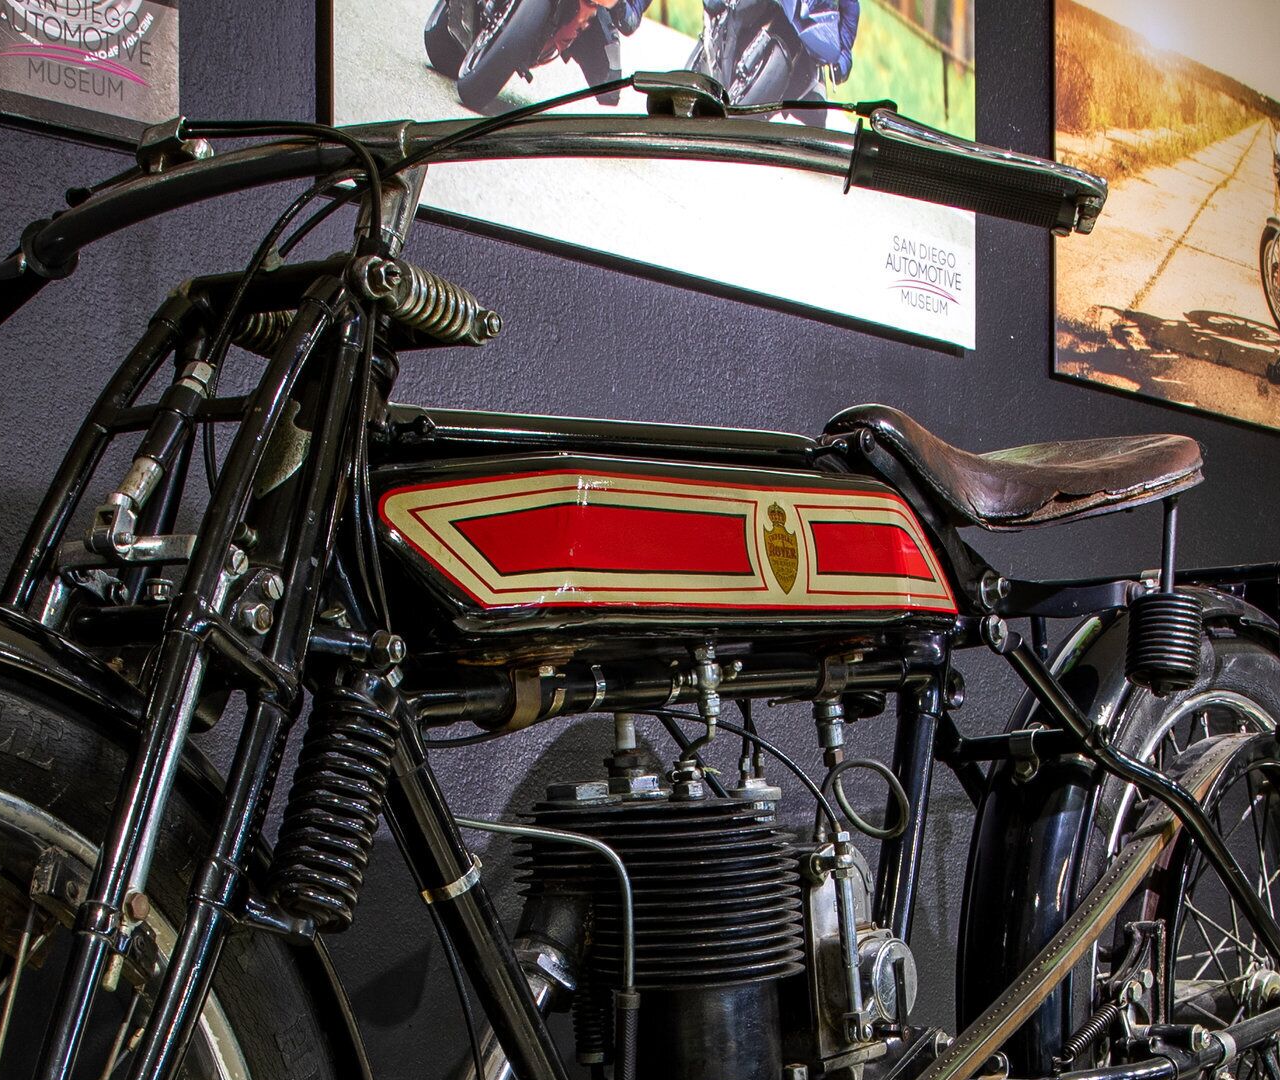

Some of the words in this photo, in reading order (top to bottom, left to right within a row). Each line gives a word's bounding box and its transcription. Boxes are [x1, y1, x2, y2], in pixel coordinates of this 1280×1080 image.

[0, 6, 152, 67] AUTOMOTIVE
[27, 57, 125, 101] MUSEUM
[885, 252, 962, 291] AUTOMOTIVE
[893, 235, 916, 257] SAN
[919, 243, 956, 269] DIEGO
[901, 288, 948, 316] MUSEUM
